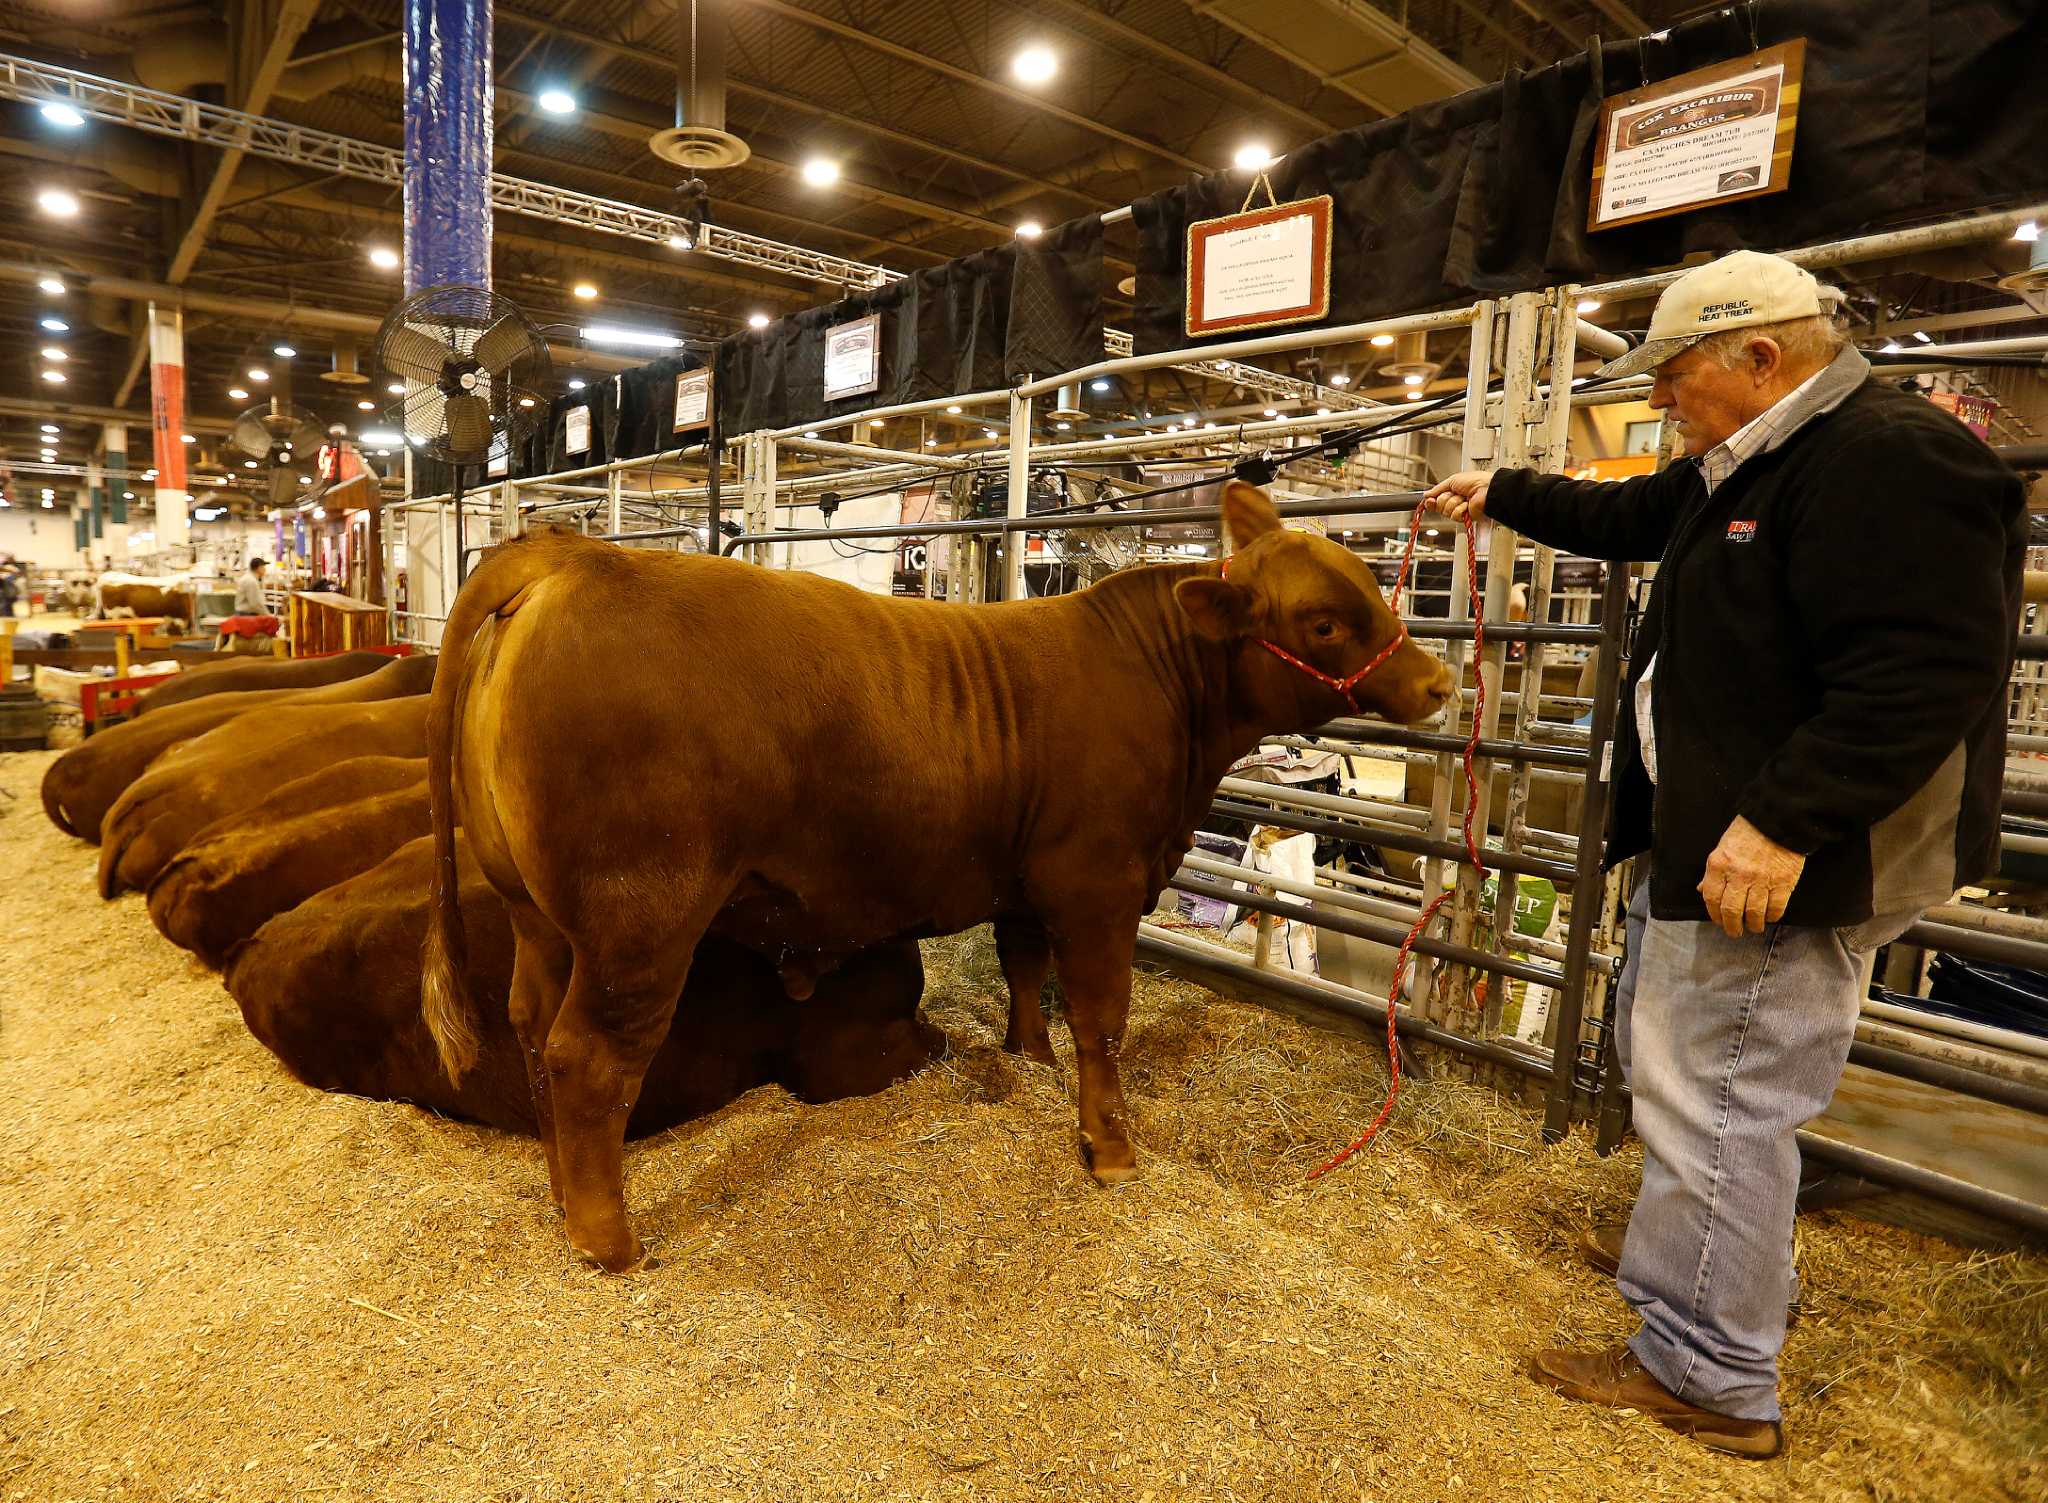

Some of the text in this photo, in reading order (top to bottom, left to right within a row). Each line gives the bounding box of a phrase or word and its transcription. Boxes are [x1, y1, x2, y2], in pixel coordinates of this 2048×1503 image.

[1637, 93, 1754, 130] COX EXCALIBUR
[1659, 113, 1726, 136] BRANGUS
[1692, 132, 1723, 144] DREAM
[1703, 300, 1749, 314] REPUBLIC
[1698, 308, 1753, 323] HEAT TREAT
